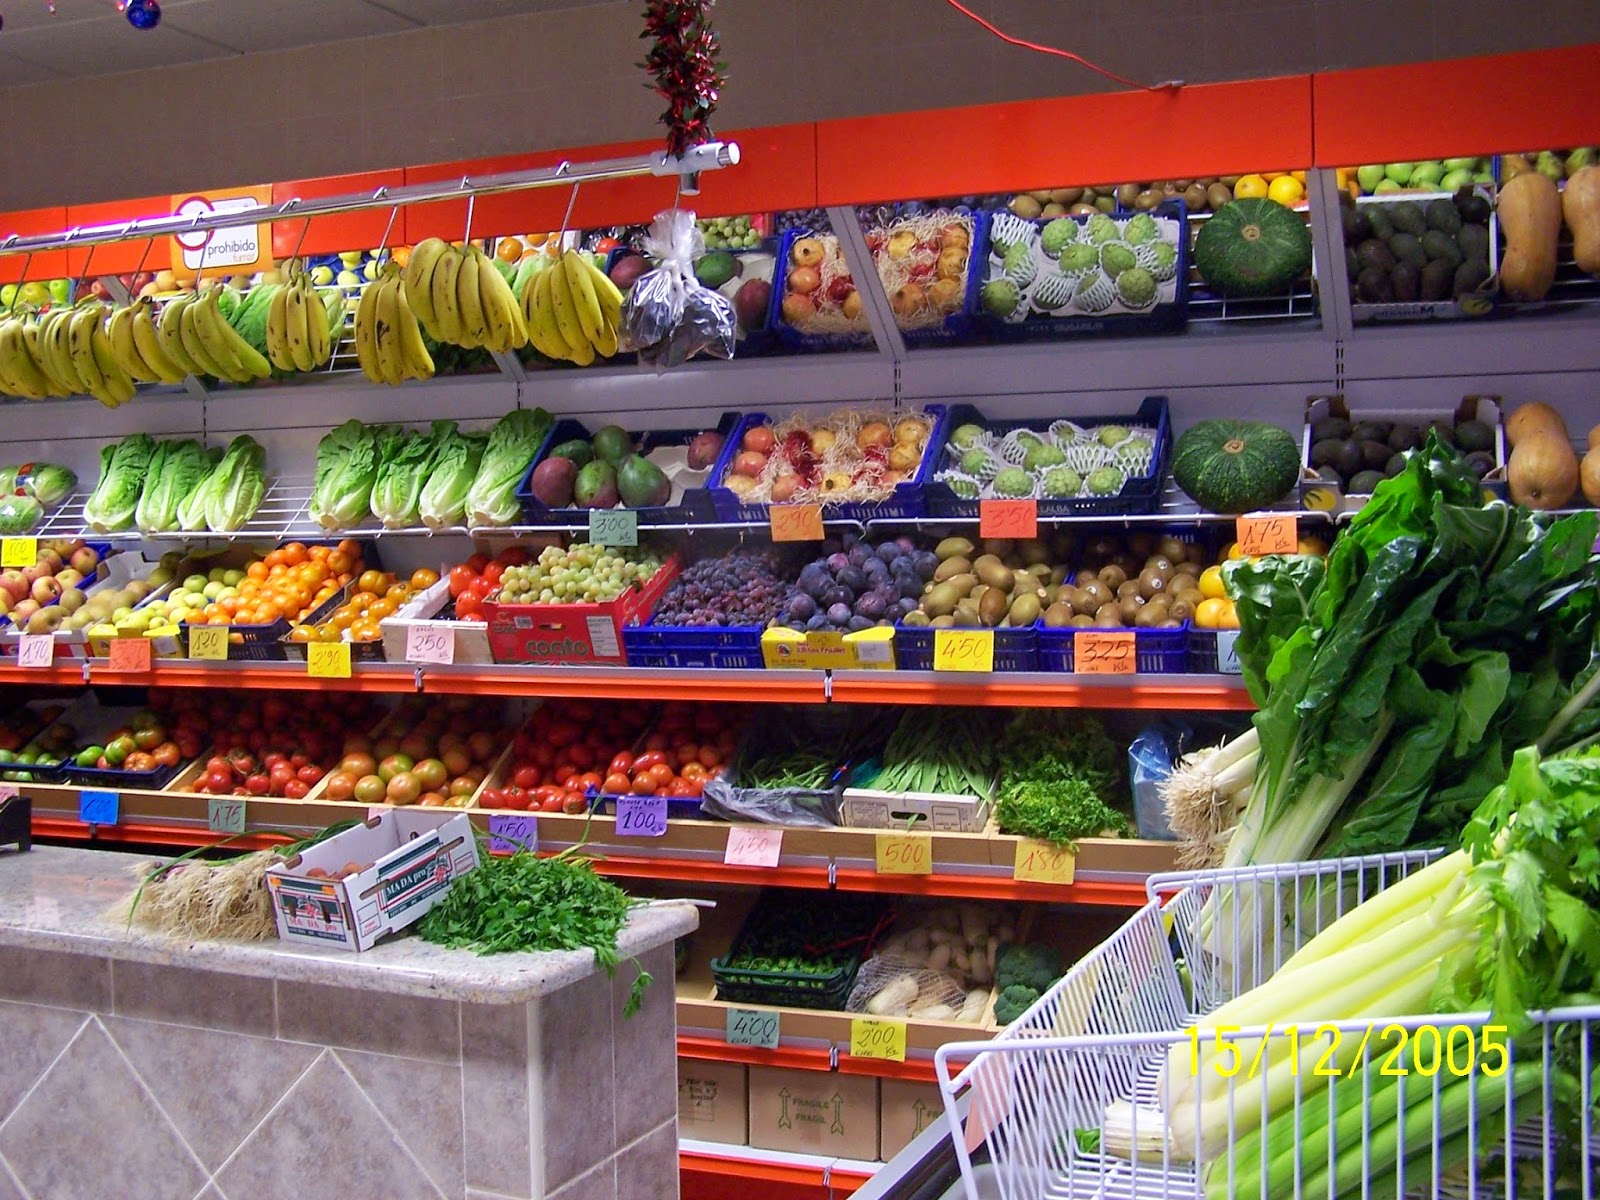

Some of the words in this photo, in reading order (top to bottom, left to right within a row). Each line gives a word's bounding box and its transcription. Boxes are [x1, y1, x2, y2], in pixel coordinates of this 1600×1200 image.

[208, 239, 256, 259] prohibido
[792, 1097, 829, 1109] FRAGILE
[795, 1113, 827, 1124] FRAGIL
